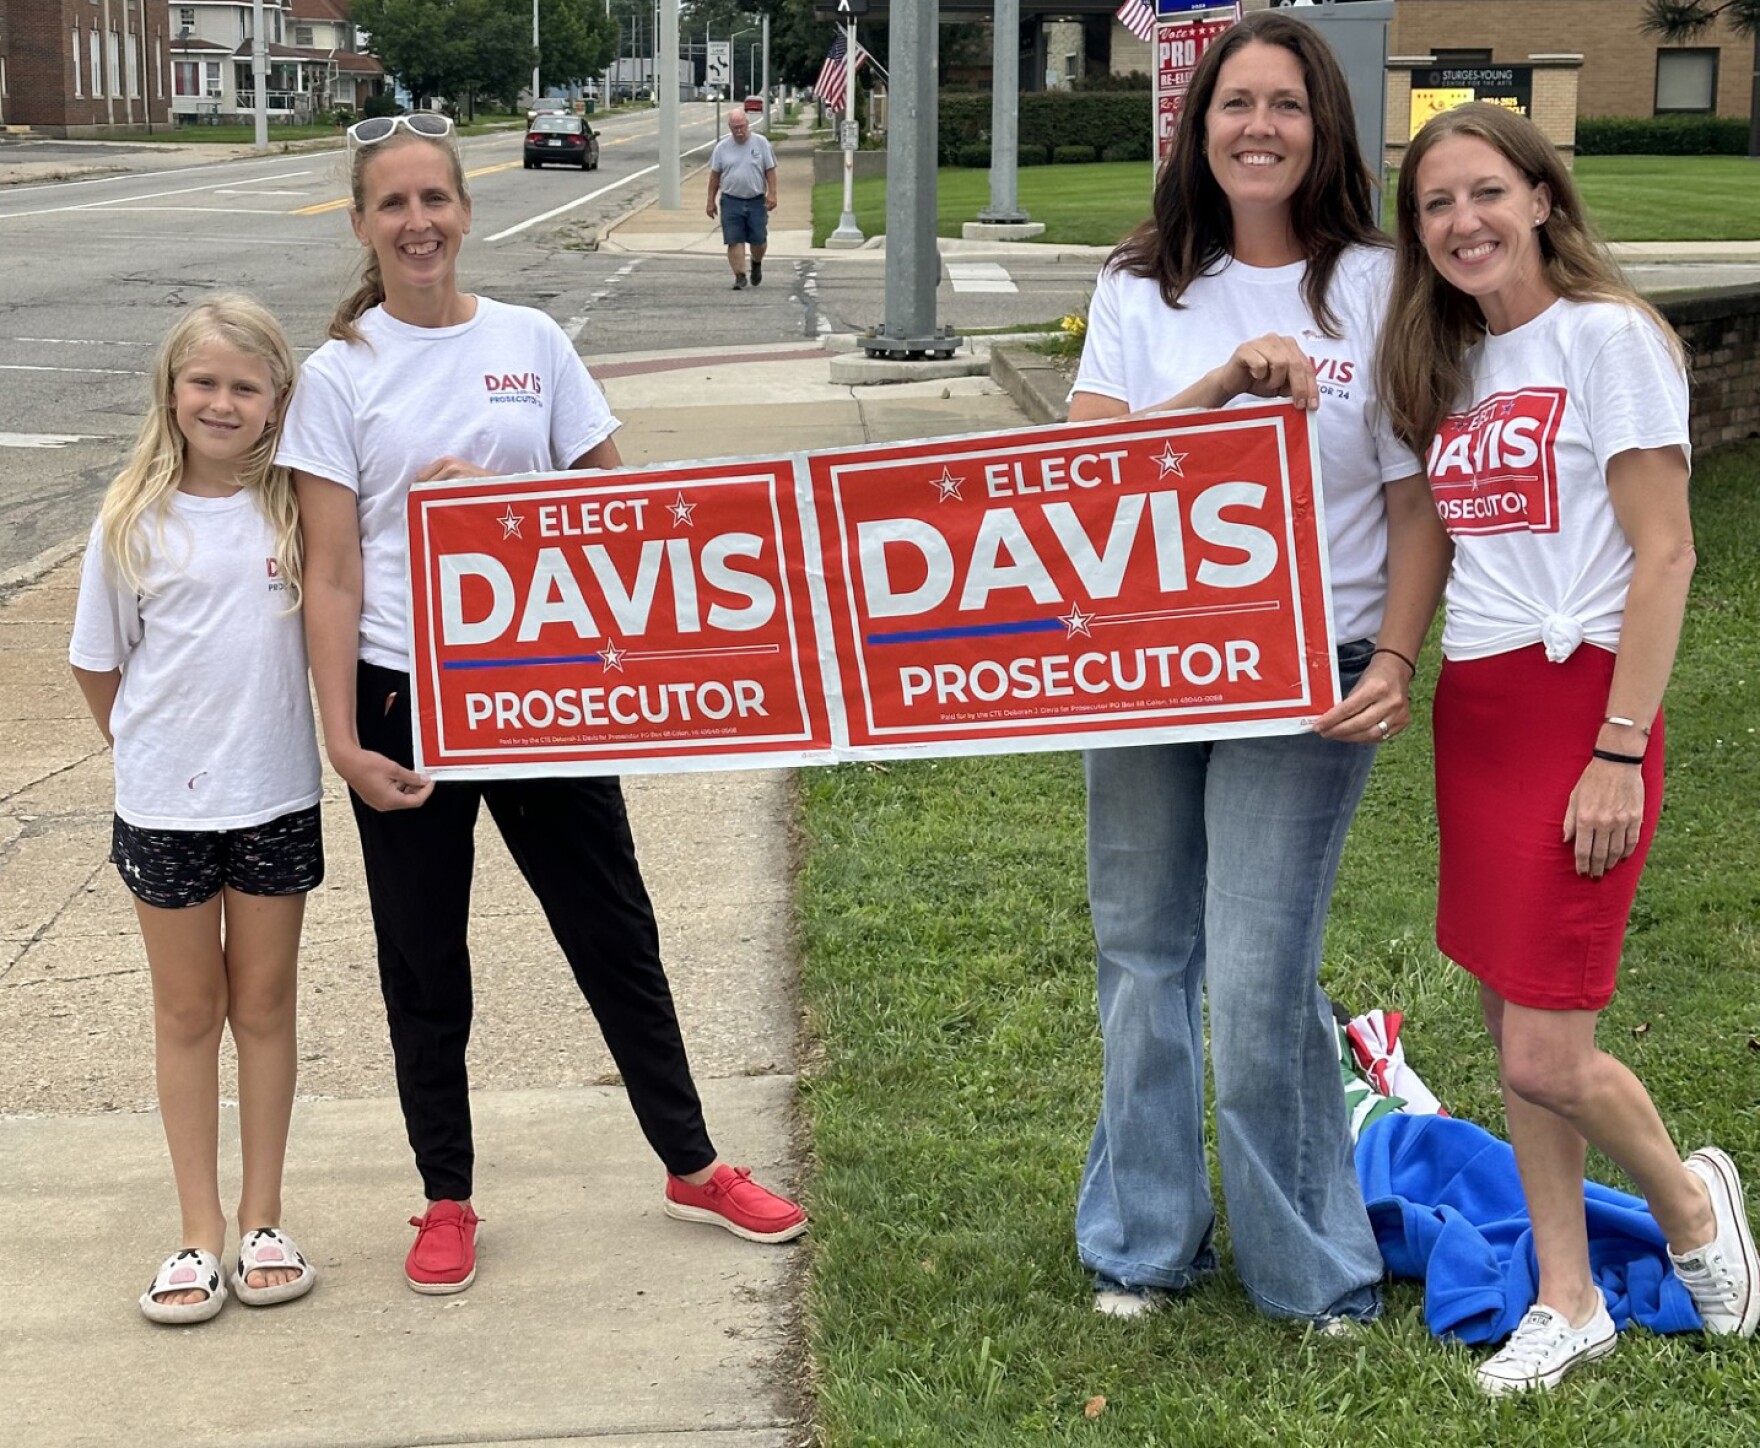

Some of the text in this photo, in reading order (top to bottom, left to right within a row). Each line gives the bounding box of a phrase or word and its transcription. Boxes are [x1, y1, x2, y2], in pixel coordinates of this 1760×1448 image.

[1160, 27, 1188, 40] Vote
[1159, 39, 1196, 69] PRO
[1160, 72, 1195, 86] RE-ELE
[1442, 69, 1513, 80] STURGES-YOUNG
[1308, 356, 1355, 383] VIS
[984, 449, 1128, 499] ELECT
[539, 498, 649, 537] ELECT
[856, 481, 1280, 618] DAVIS
[438, 532, 777, 646] DAVIS
[899, 639, 1263, 706] PROSECUTOR
[465, 679, 769, 731] PROSECUTOR
[989, 710, 1002, 718] CTE
[1003, 708, 1033, 716] Deborah
[1071, 703, 1108, 711] Prosecutor
